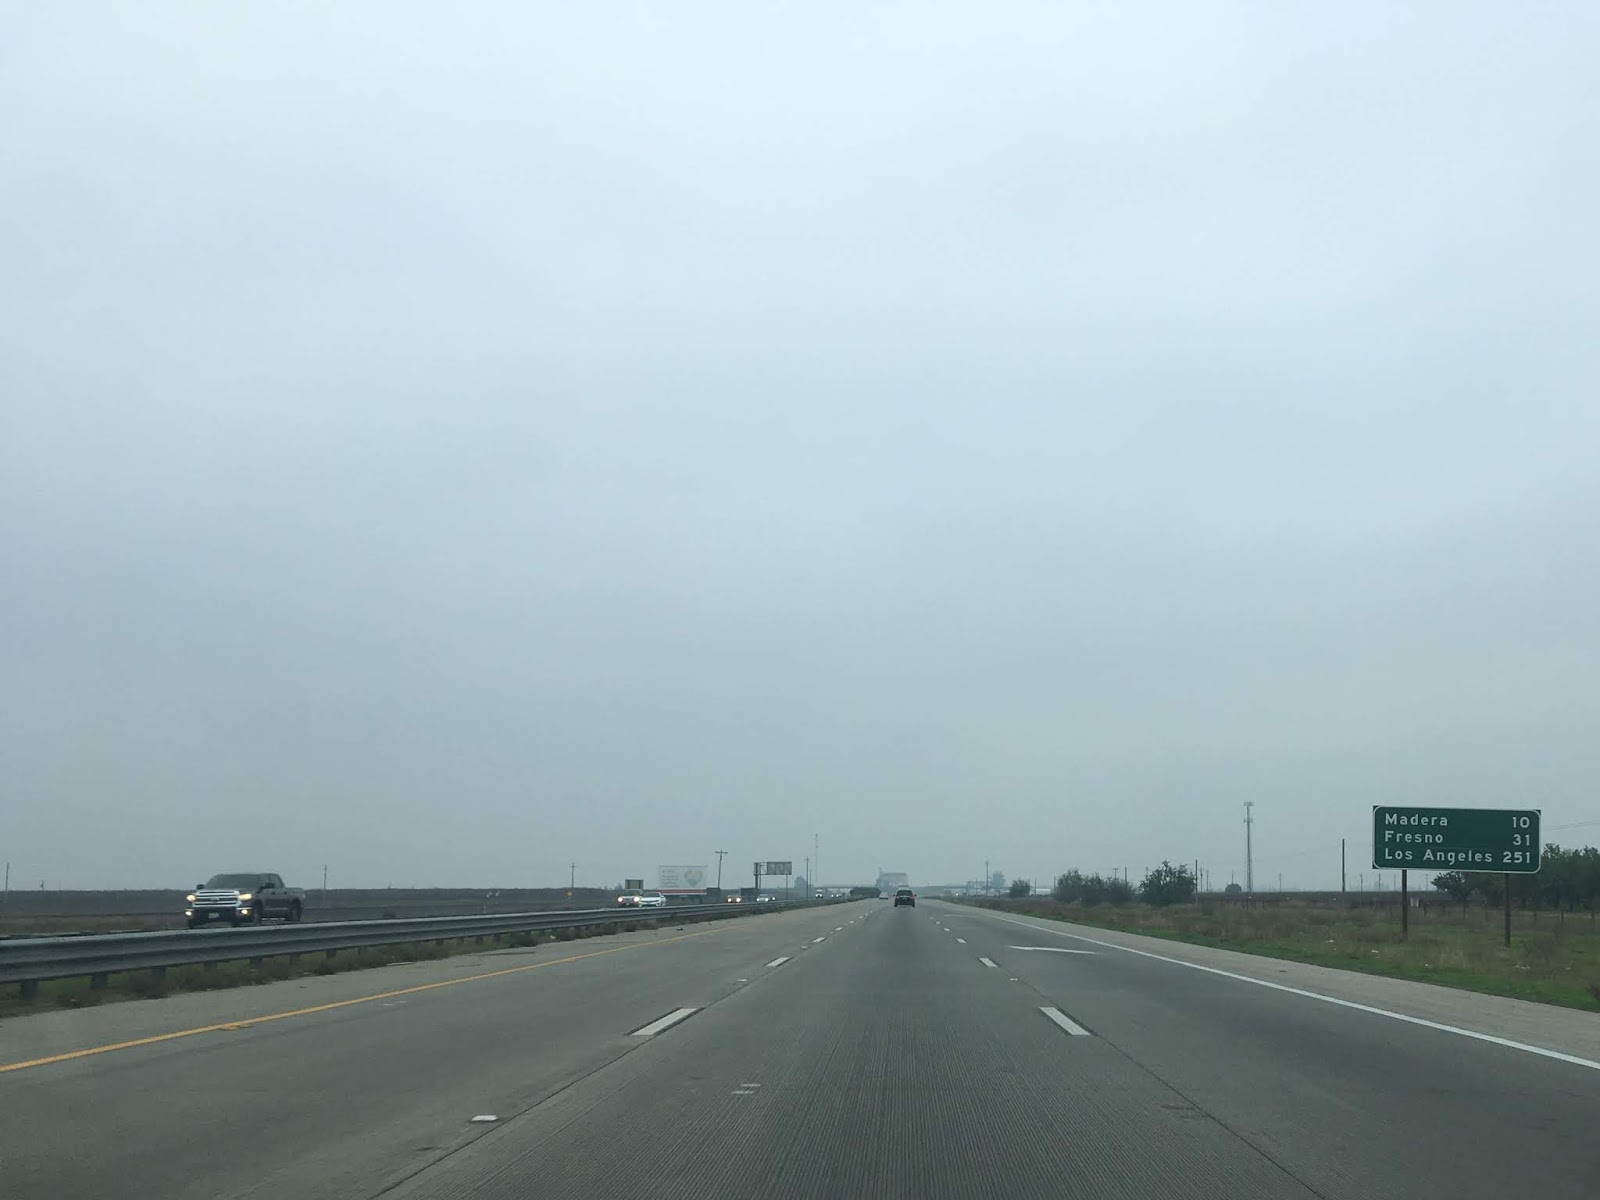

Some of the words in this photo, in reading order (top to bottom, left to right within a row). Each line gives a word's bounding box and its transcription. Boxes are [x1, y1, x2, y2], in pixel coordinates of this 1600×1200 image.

[1385, 813, 1448, 826] Madera
[1512, 816, 1530, 828] 10
[1385, 830, 1444, 843] Fresno
[1512, 833, 1530, 845] 31
[1385, 848, 1413, 860] Los
[1423, 849, 1493, 865] Angeles
[1502, 851, 1530, 863] 251
